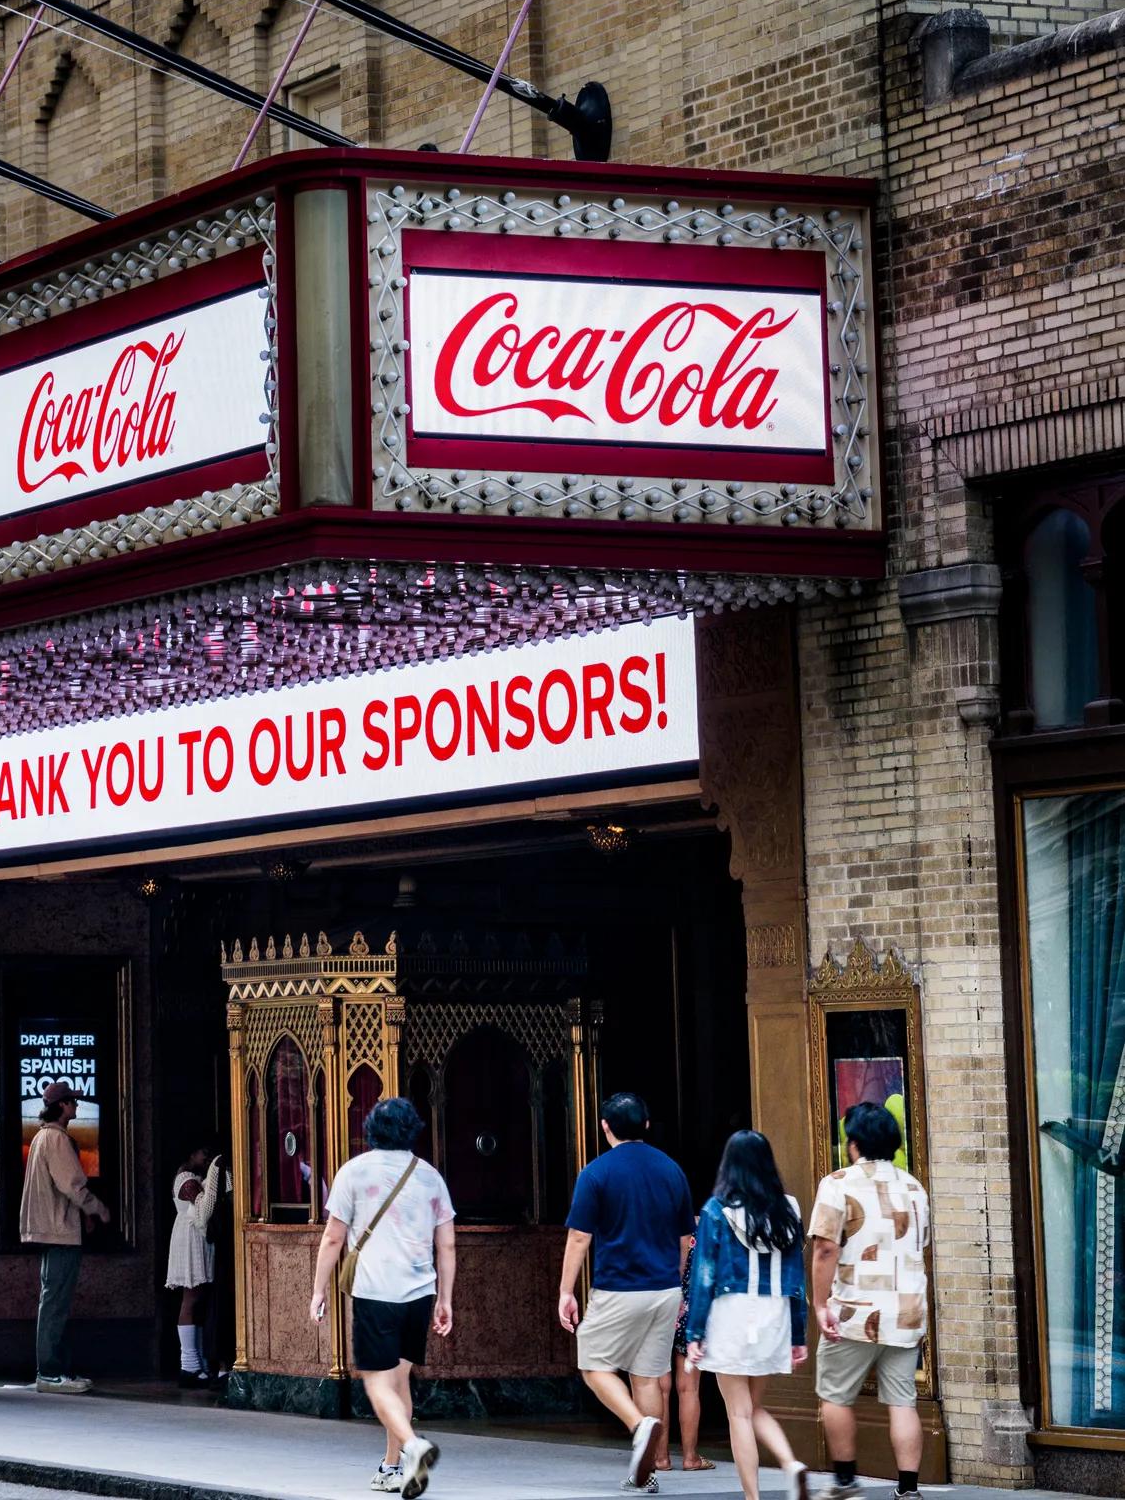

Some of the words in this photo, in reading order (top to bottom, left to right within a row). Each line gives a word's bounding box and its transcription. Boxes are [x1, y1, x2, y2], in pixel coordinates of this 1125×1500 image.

[434, 292, 797, 431] Coca-Cola
[16, 331, 184, 494] Coca-Cola
[81, 736, 165, 809] YOU
[178, 725, 235, 796] TO
[248, 706, 347, 786] OUR
[362, 652, 668, 772] SPONSORS!
[20, 1034, 60, 1046] DRAFT
[63, 1034, 95, 1046] BEER
[20, 1058, 95, 1074] SPANISH
[41, 1047, 52, 1057] IN
[54, 1047, 74, 1057] THE
